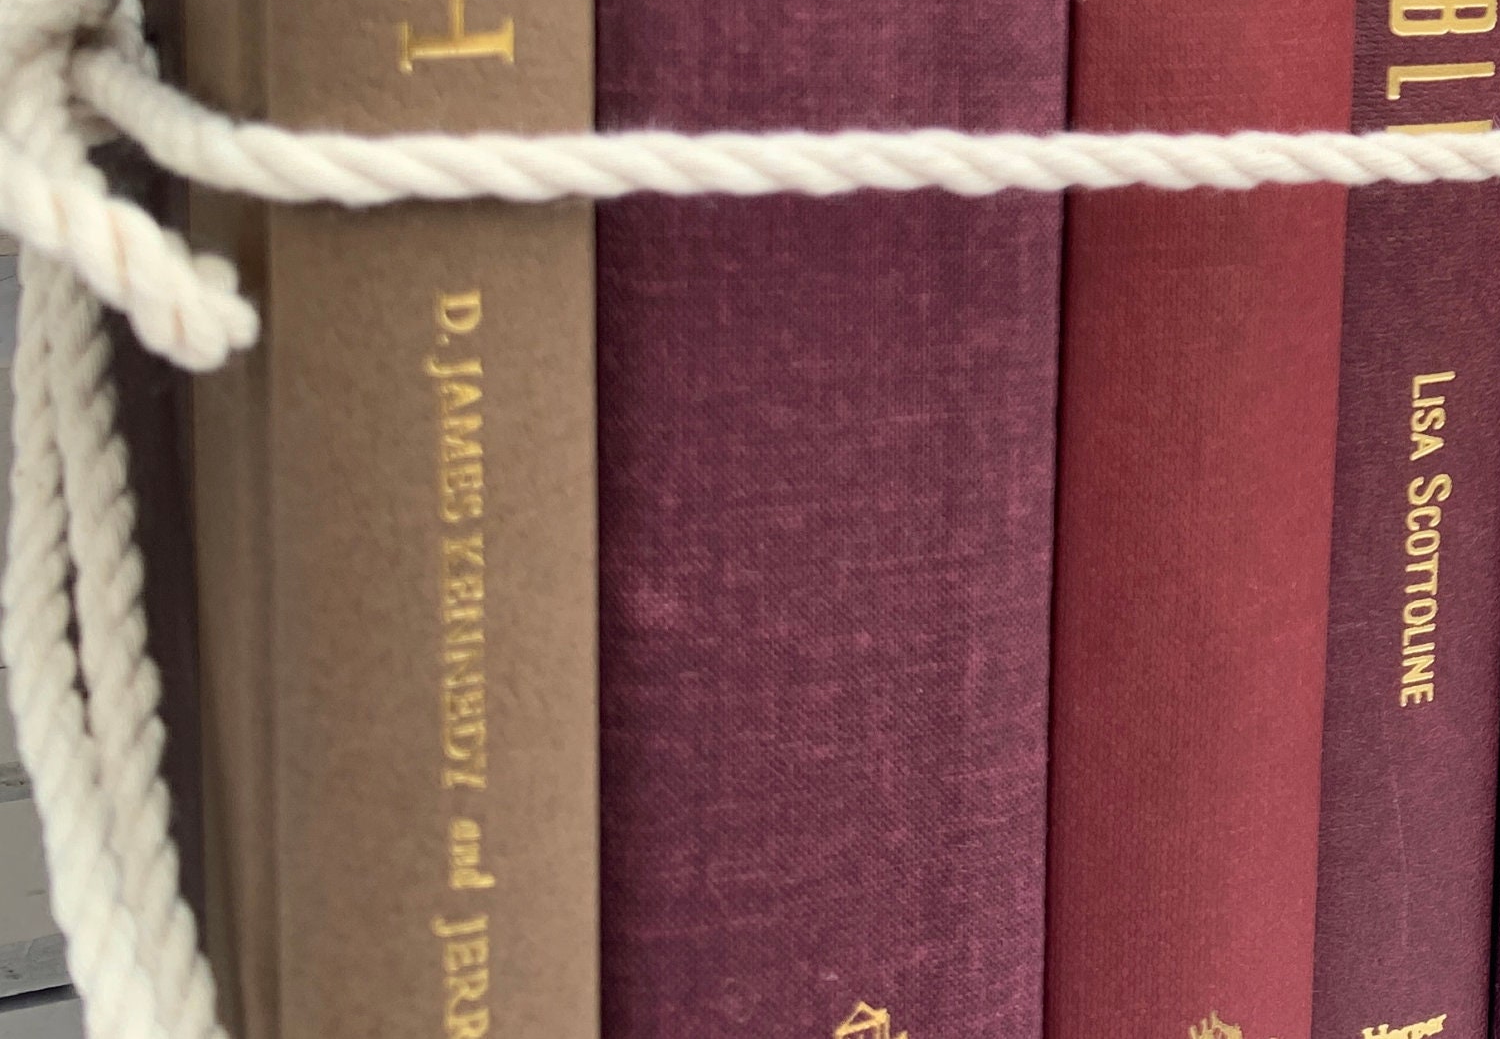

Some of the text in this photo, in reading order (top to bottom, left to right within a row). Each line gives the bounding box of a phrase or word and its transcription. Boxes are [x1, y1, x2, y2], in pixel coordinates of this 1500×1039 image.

[424, 289, 496, 1039] D. JAMES KENNEDY and JERR
[1400, 371, 1456, 707] LISA SCOTTOLINE
